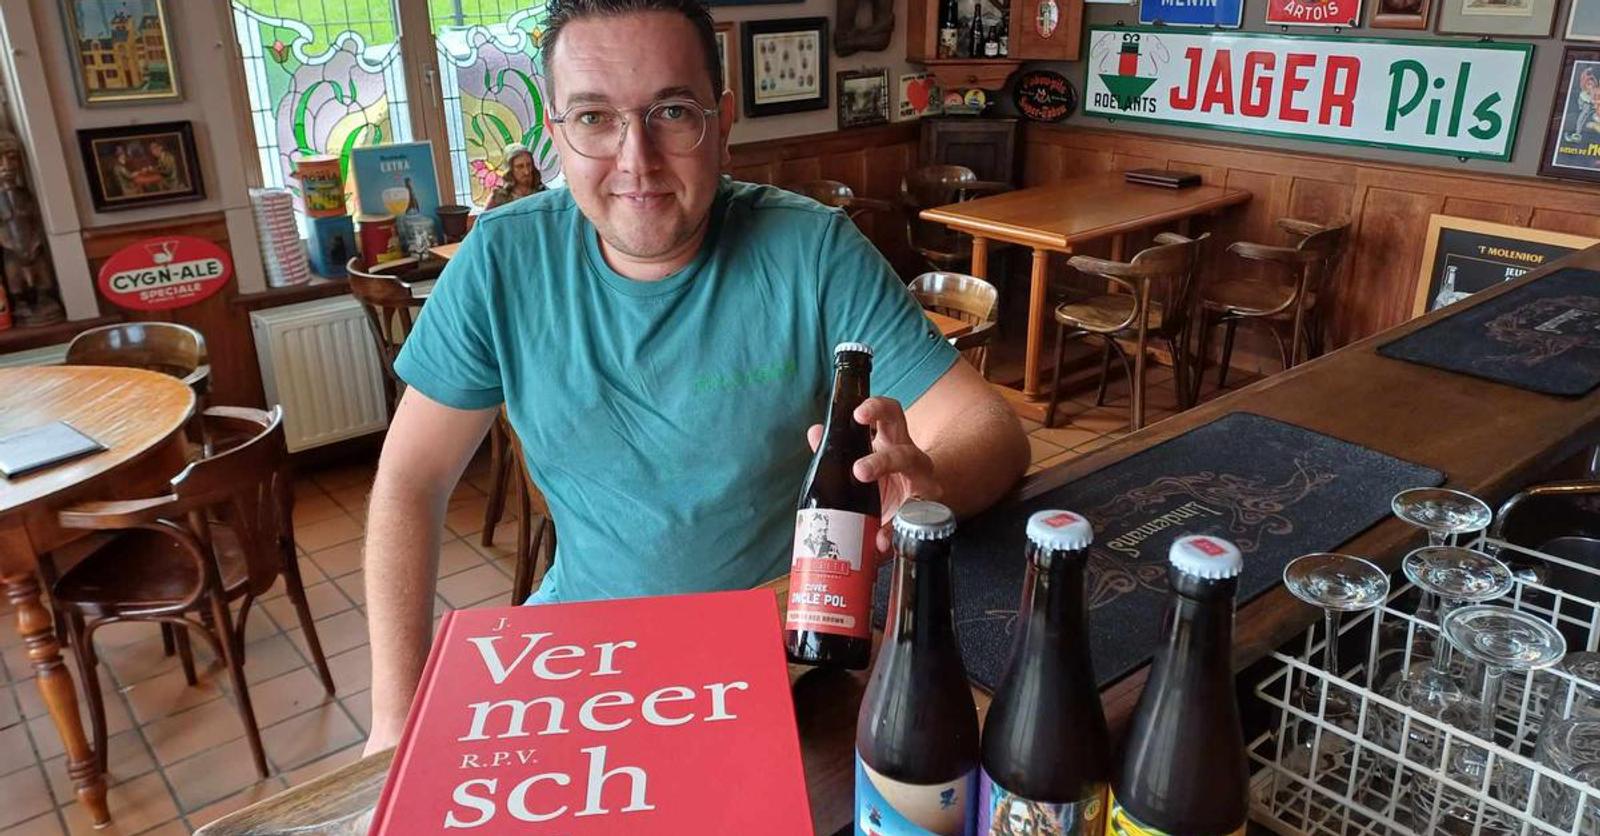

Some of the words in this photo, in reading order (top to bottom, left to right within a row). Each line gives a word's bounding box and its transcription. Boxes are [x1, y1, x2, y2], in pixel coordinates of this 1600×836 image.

[1284, 1, 1339, 21] ARTOIS
[1094, 92, 1157, 113] ROELANTS
[1169, 47, 1362, 128] JAGER
[1385, 59, 1502, 140] Pils
[1488, 247, 1544, 264] MOLENHOF
[113, 261, 219, 290] CYGN-ALE
[140, 282, 202, 301] SPECIALE
[1106, 500, 1223, 558] Lindemans
[824, 593, 847, 608] POL
[492, 617, 511, 631] J.
[467, 632, 637, 685] Ver
[458, 681, 749, 742] meer
[459, 749, 538, 769] R.P.V.
[443, 745, 656, 829] sch
